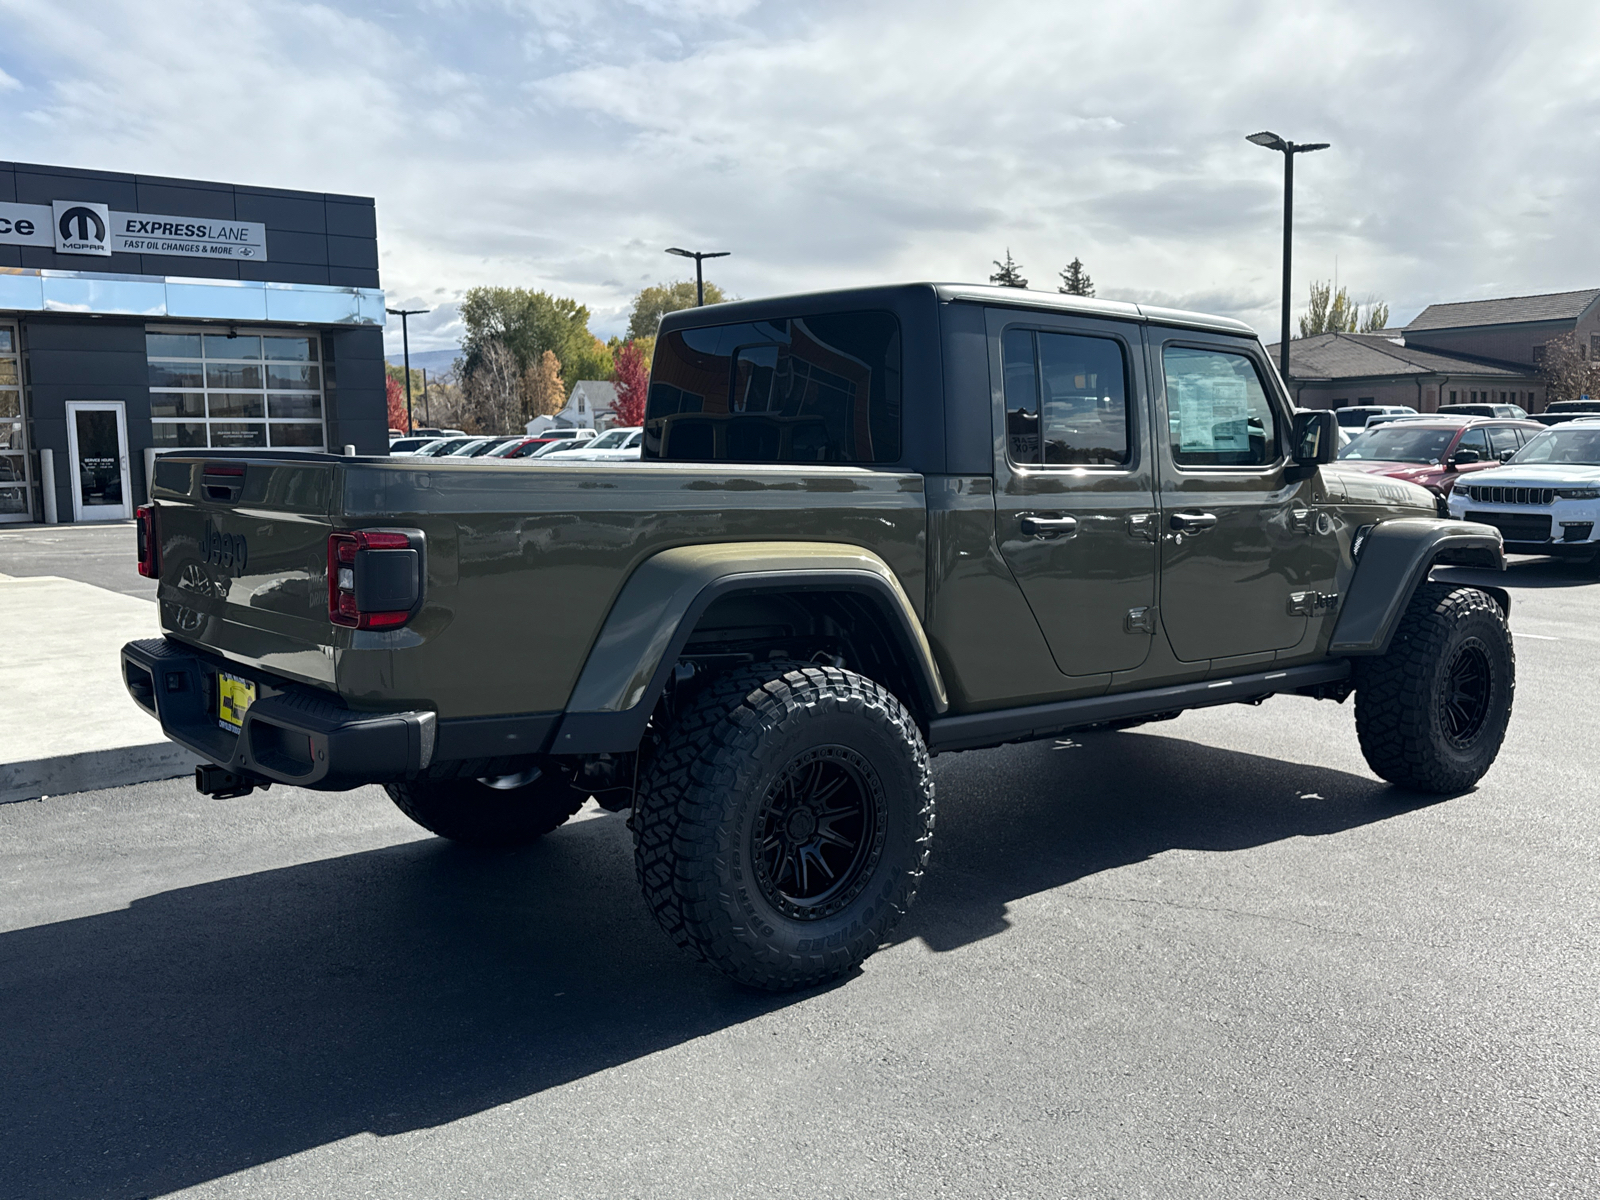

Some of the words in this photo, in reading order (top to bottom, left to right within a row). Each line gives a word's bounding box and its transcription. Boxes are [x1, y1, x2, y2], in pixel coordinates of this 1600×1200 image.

[126, 219, 249, 242] EXPRESSLANE
[63, 242, 105, 252] MOPAR
[124, 240, 145, 250] FAST
[147, 241, 159, 250] OIL
[161, 242, 200, 253] CHANGES
[202, 245, 208, 253] &
[210, 245, 233, 255] MORE
[198, 519, 248, 578] Jeep
[1314, 591, 1338, 609] Jeep
[797, 920, 861, 952] TIRES
